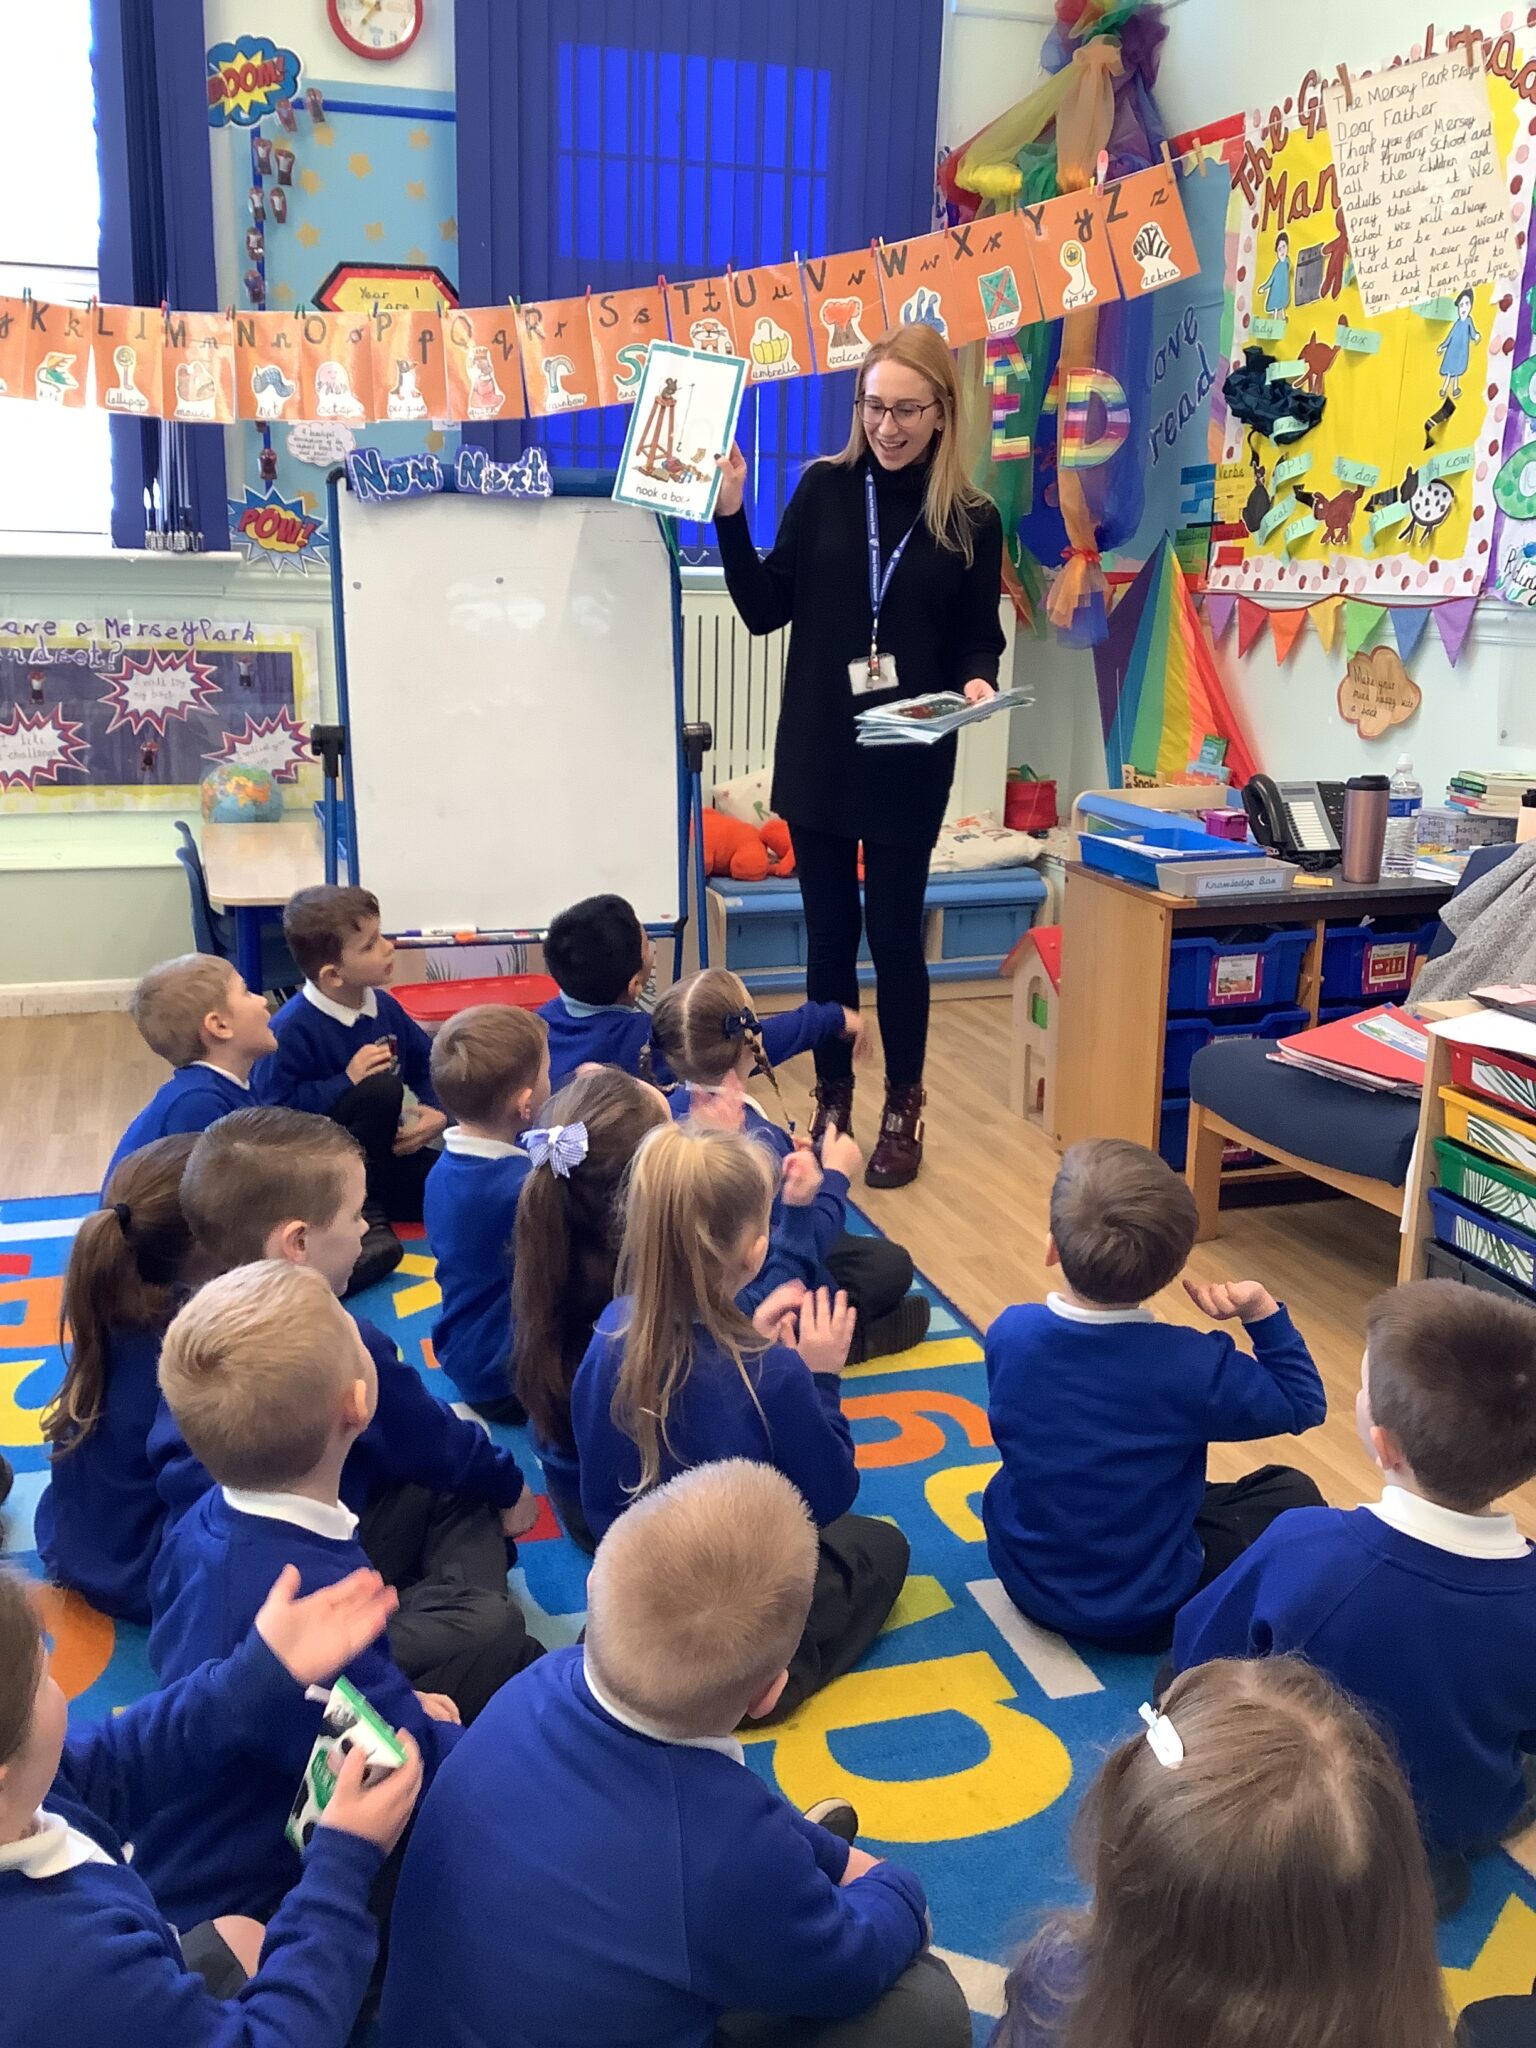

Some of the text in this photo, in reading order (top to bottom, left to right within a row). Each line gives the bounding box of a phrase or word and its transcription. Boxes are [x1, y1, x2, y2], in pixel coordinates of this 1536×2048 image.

[1368, 82, 1417, 106] Mersey
[1421, 64, 1449, 88] Park
[1338, 101, 1438, 142] Dear Father
[1334, 132, 1377, 161] Thank
[1434, 115, 1476, 134] Mersey
[1340, 121, 1492, 178] Park Primary School and
[1231, 105, 1288, 206] The
[1342, 178, 1363, 195] all
[1380, 168, 1407, 184] the
[1470, 142, 1491, 160] and
[1261, 164, 1342, 232] Man
[1346, 192, 1382, 212] adults
[1393, 182, 1428, 198] inside
[1468, 161, 1494, 178] We
[1103, 184, 1170, 223] Z z
[1350, 214, 1378, 232] pray
[1387, 201, 1412, 217] that
[1419, 205, 1443, 226] will
[1024, 205, 1094, 243] Y y
[951, 225, 974, 261] X
[1354, 245, 1379, 261] try
[1387, 235, 1404, 251] to
[1414, 229, 1432, 244] be
[880, 245, 908, 279] W
[1358, 256, 1390, 275] hard
[1394, 247, 1417, 265] and
[1430, 244, 1461, 257] never
[1361, 280, 1376, 290] so
[1392, 265, 1421, 283] that
[1430, 261, 1450, 273] we
[1492, 246, 1505, 257] to
[733, 274, 793, 308] U u
[806, 260, 827, 292] V
[1143, 268, 1179, 286] zebra
[1400, 281, 1421, 296] and
[359, 286, 390, 300] Year
[673, 280, 721, 316] T t
[31, 301, 84, 338] K k
[98, 308, 114, 336] L
[525, 308, 546, 341] R
[599, 295, 619, 328] S
[989, 318, 1016, 332] box
[164, 319, 187, 348] M
[237, 320, 291, 348] N n
[304, 316, 327, 344] O
[377, 312, 434, 364] P p
[492, 330, 513, 361] q
[1153, 306, 1199, 385] ove
[752, 364, 800, 379] umbrella
[829, 350, 866, 366] volcan
[107, 392, 146, 412] lollipop
[618, 388, 637, 399] sna
[1150, 342, 1215, 466] read
[352, 449, 551, 498] Now Next
[1218, 465, 1245, 479] Verbs
[1355, 467, 1377, 484] dog
[661, 492, 668, 500] a
[238, 508, 319, 548] POW!
[0, 620, 57, 636] ave
[1353, 665, 1375, 686] Make
[1205, 875, 1276, 889] Knowledge Box
